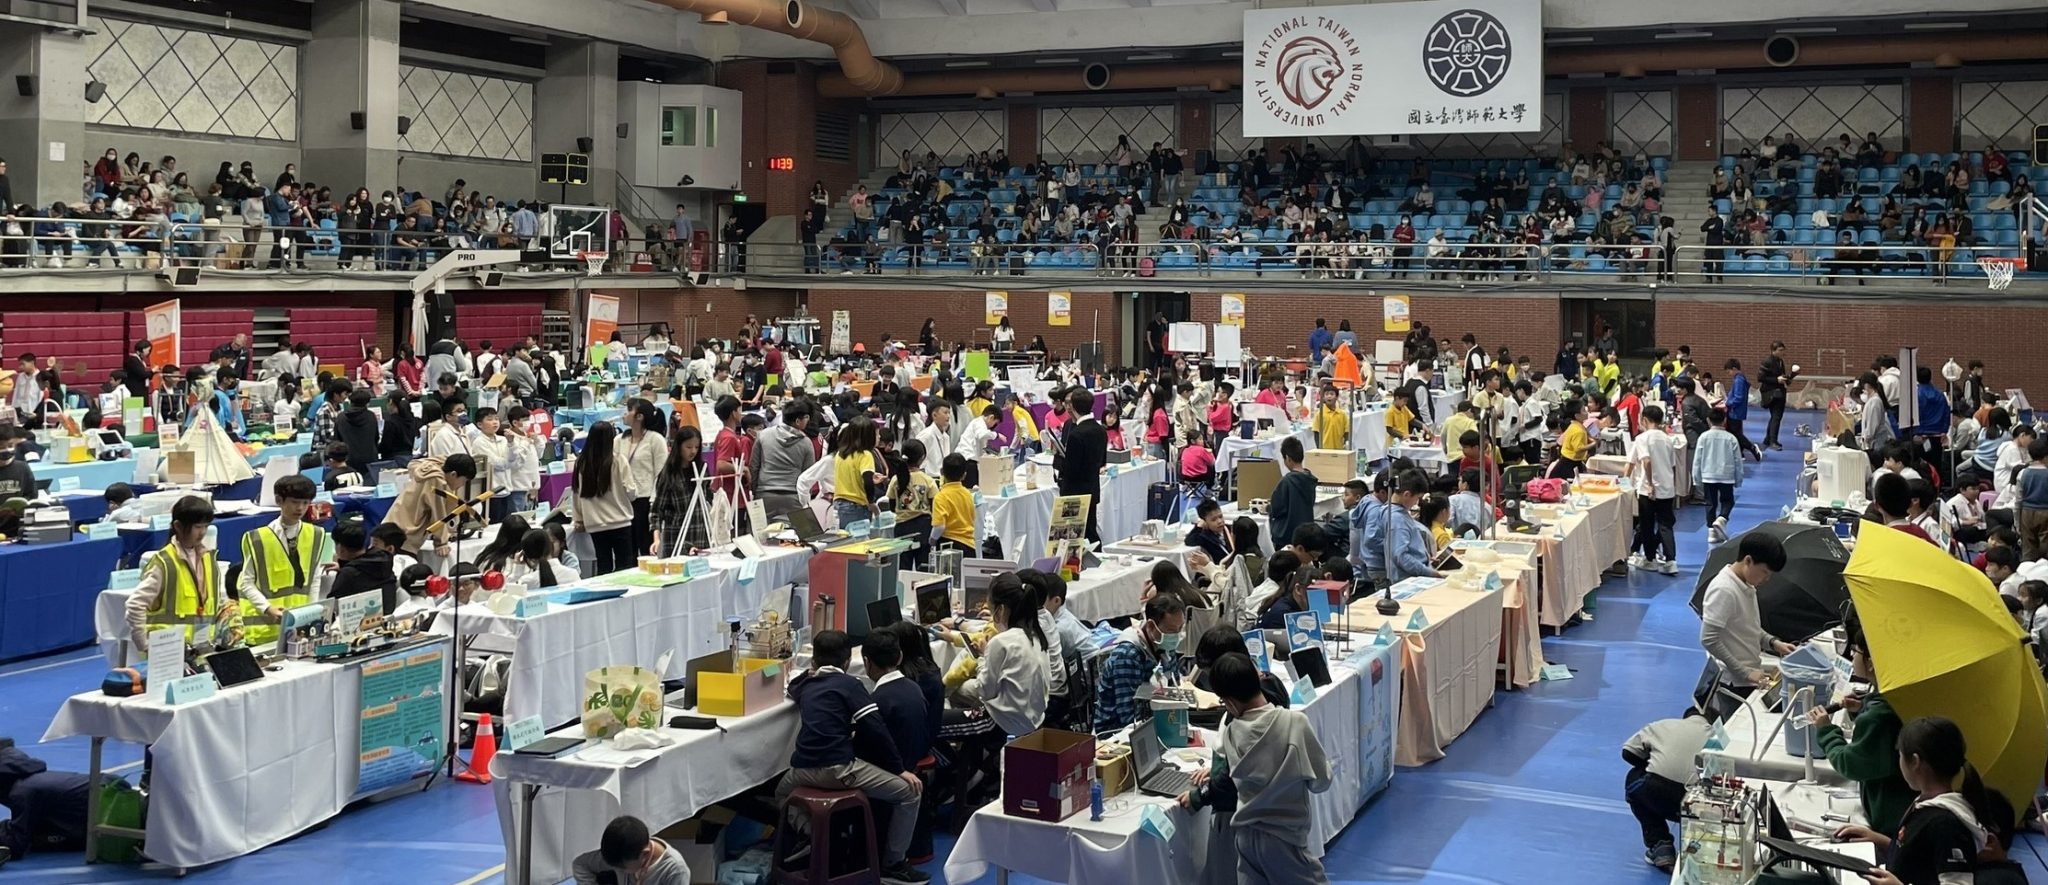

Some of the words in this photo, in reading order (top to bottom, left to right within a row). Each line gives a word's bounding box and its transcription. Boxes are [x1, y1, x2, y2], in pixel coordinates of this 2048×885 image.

[1255, 16, 1308, 67] NATIONAL
[1318, 16, 1360, 56] TAIWAN
[1255, 80, 1325, 127] UNIVERSITY
[1330, 63, 1363, 116] NORMAL
[457, 253, 475, 261] PRO
